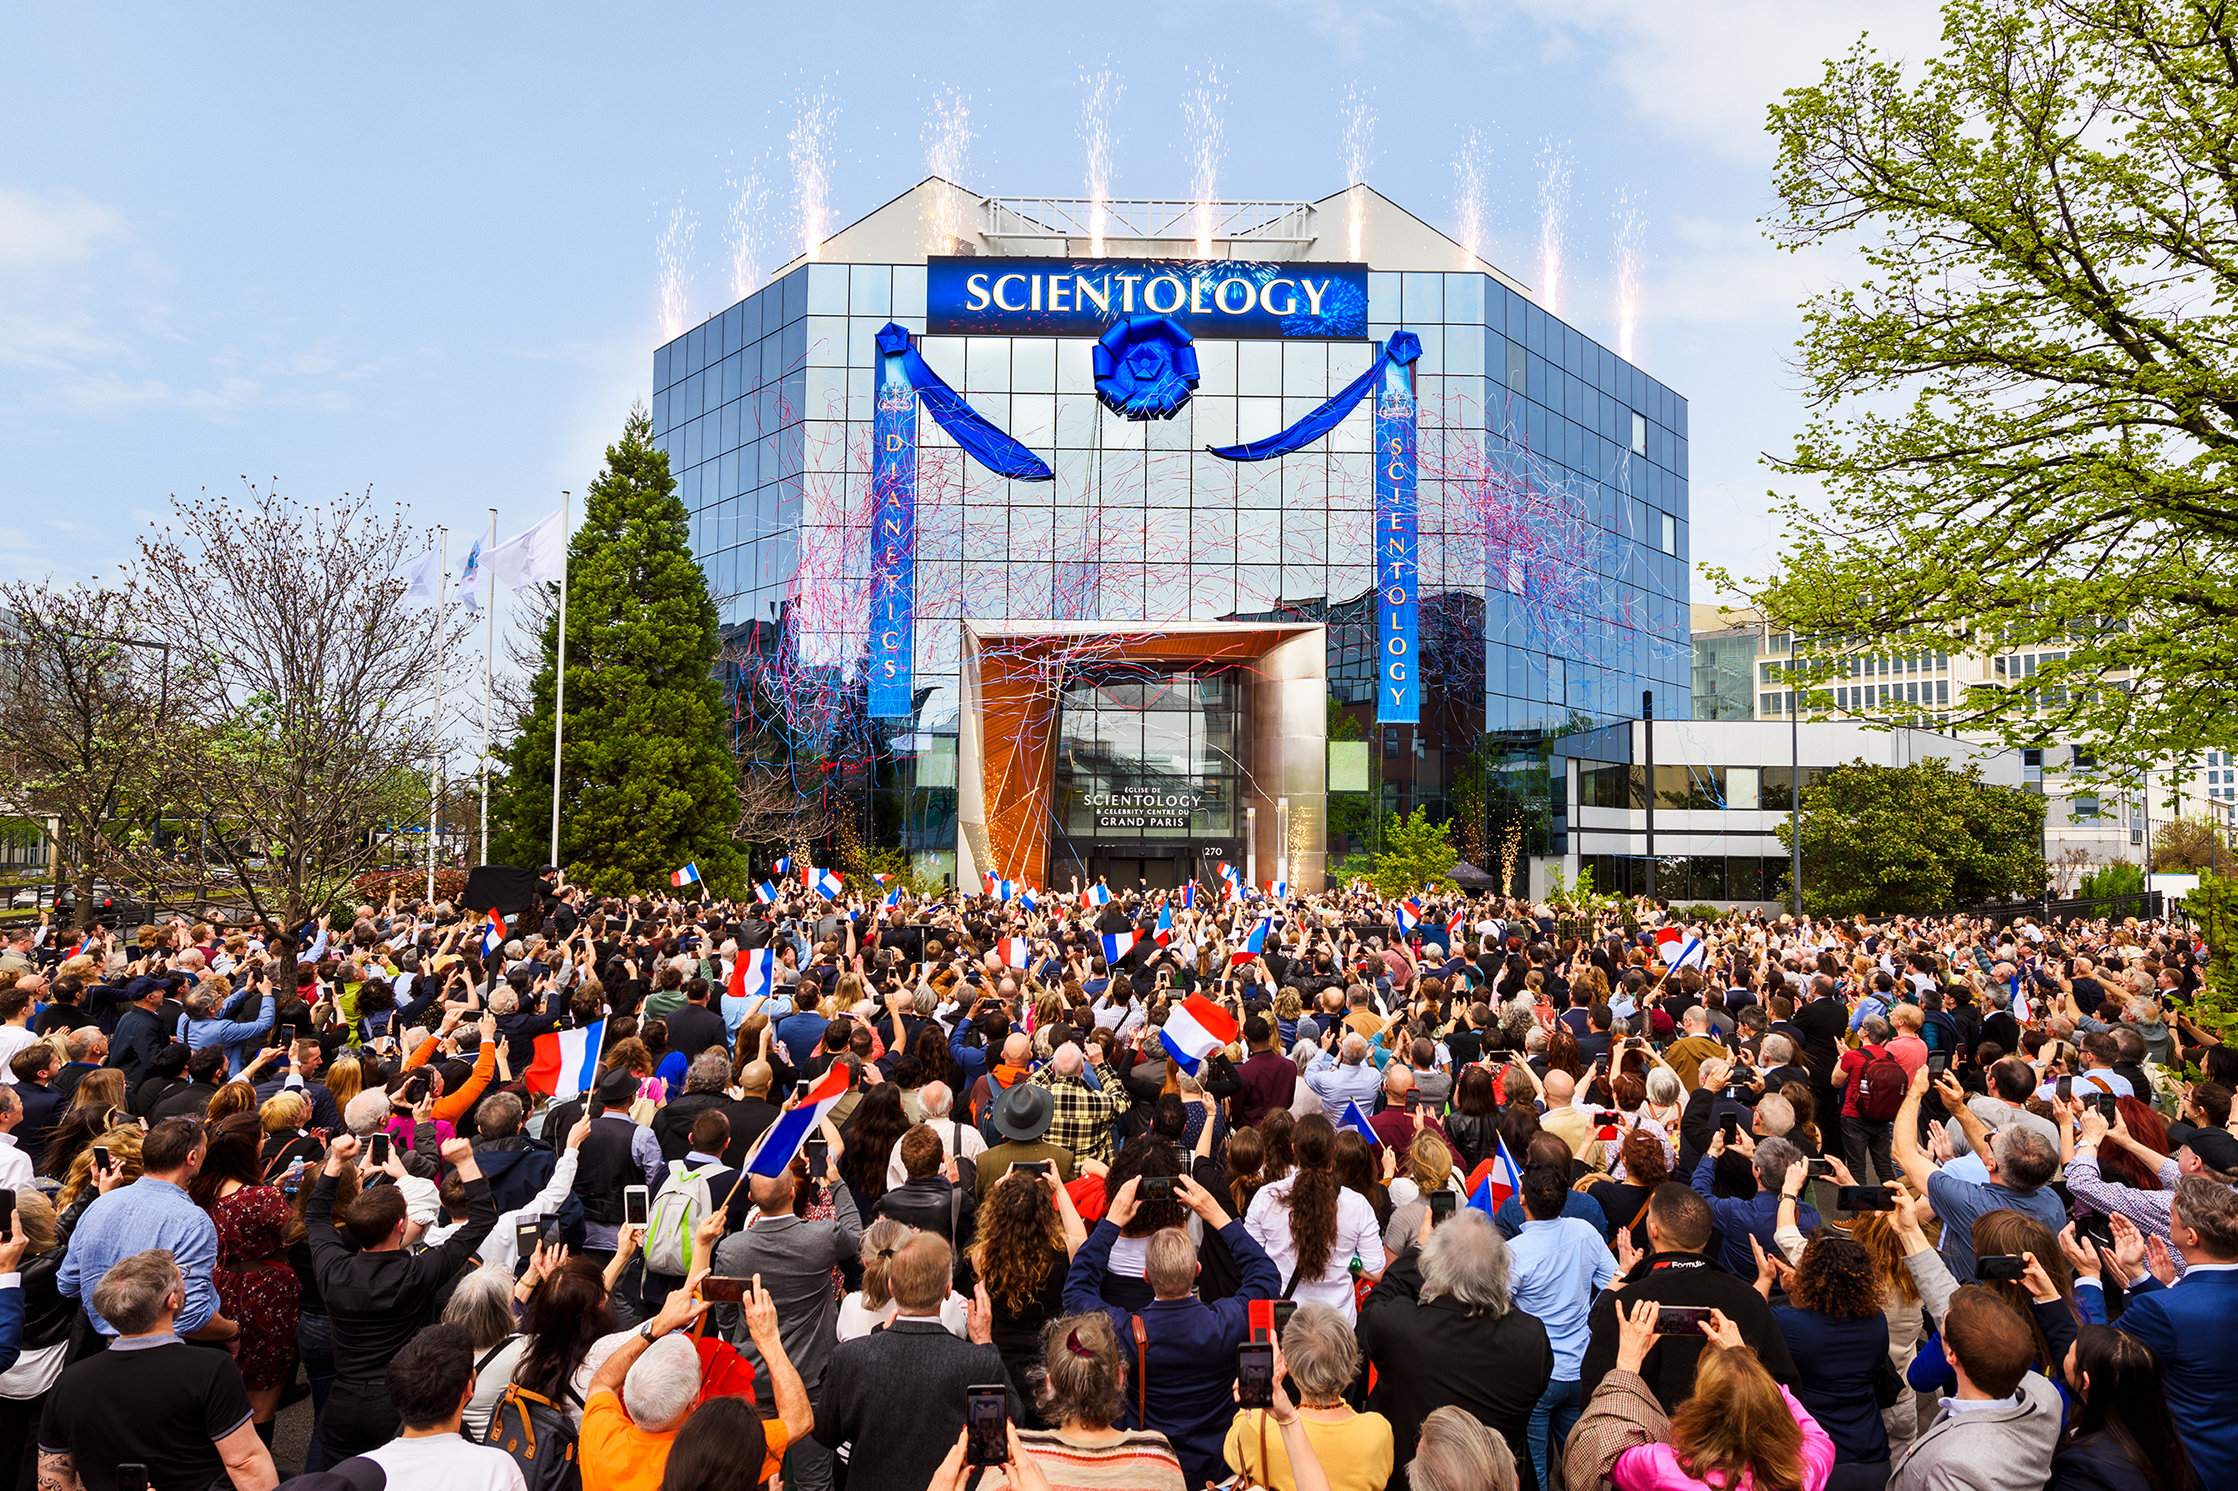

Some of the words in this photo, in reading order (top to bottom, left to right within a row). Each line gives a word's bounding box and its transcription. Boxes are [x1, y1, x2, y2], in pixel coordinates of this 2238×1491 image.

[965, 273, 1331, 317] SCIENTOLOGY
[881, 434, 903, 679] DIANETICS
[1387, 437, 1407, 706] SCIENTOLOGY
[1084, 794, 1201, 807] SCIENTOLOGY
[1101, 817, 1145, 827] GRAND
[1150, 817, 1184, 827] PARIS
[1204, 847, 1223, 856] 270
